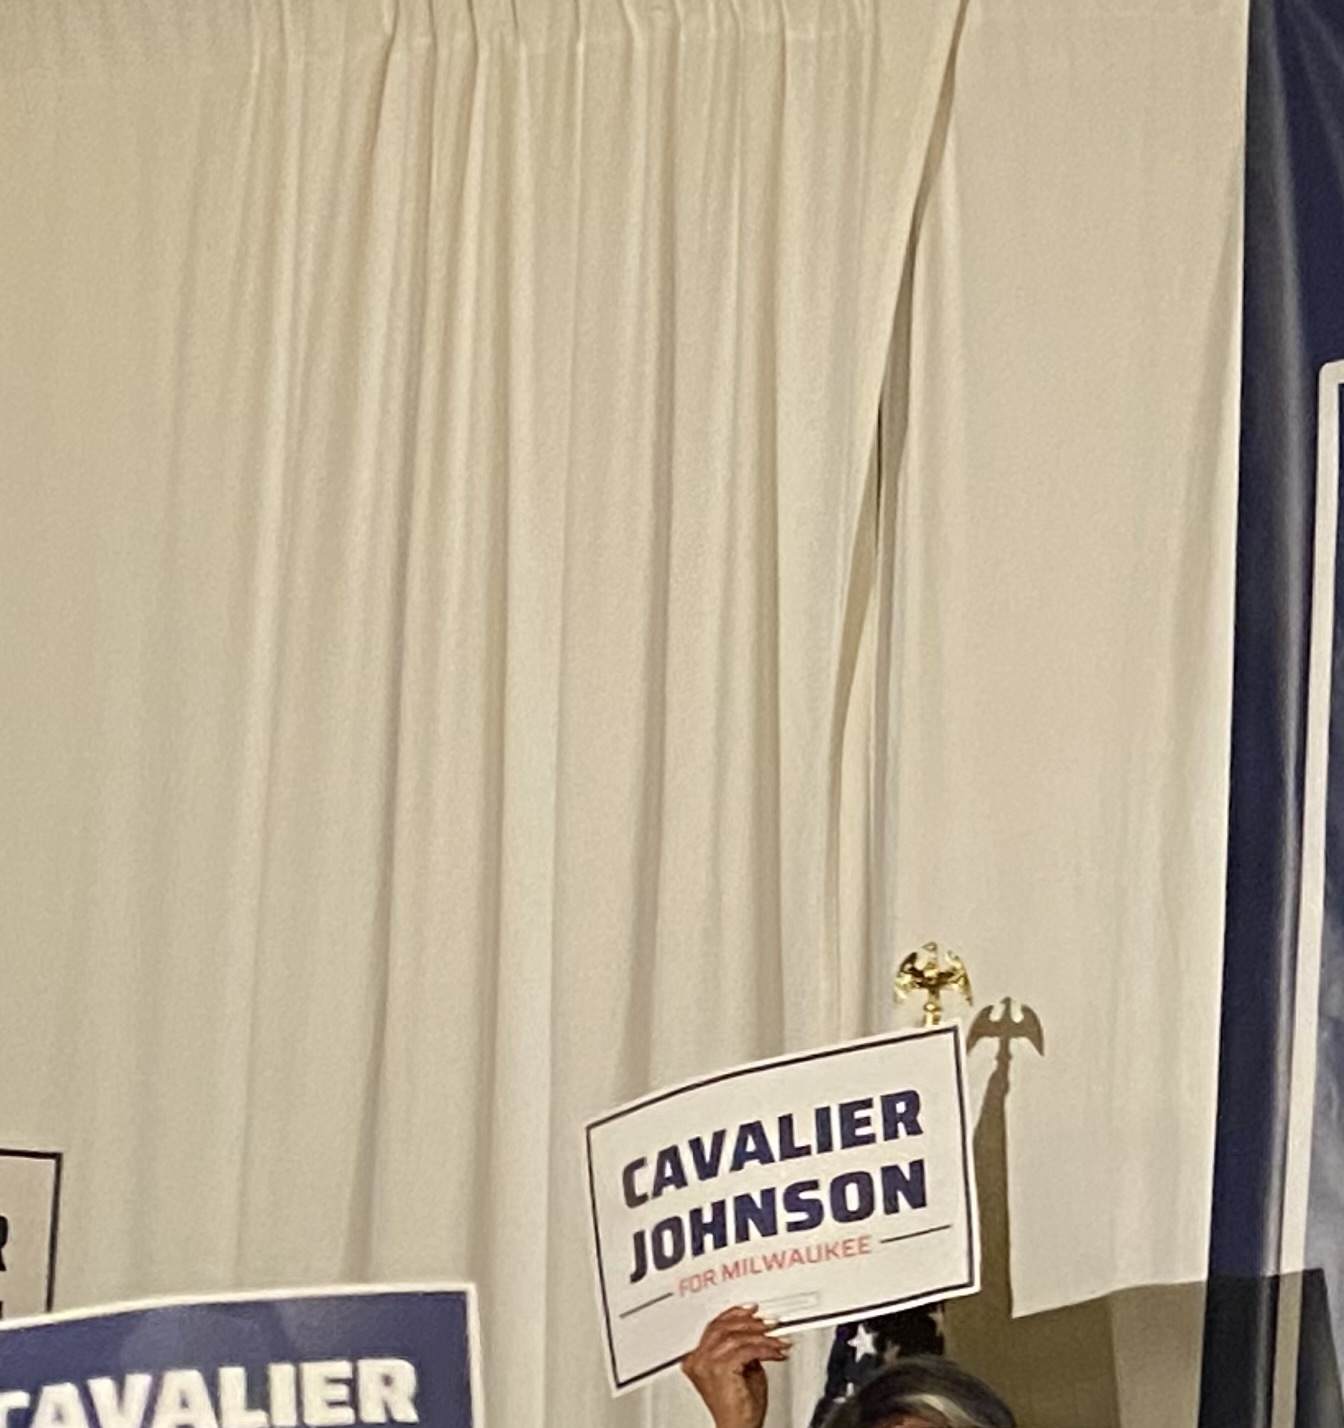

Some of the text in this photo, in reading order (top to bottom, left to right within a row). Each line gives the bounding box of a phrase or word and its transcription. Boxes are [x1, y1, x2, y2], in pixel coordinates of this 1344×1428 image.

[622, 1090, 923, 1208] CAVALIER
[629, 1159, 927, 1283] JOHNSON
[678, 1235, 872, 1296] FOR MILWAUKEE
